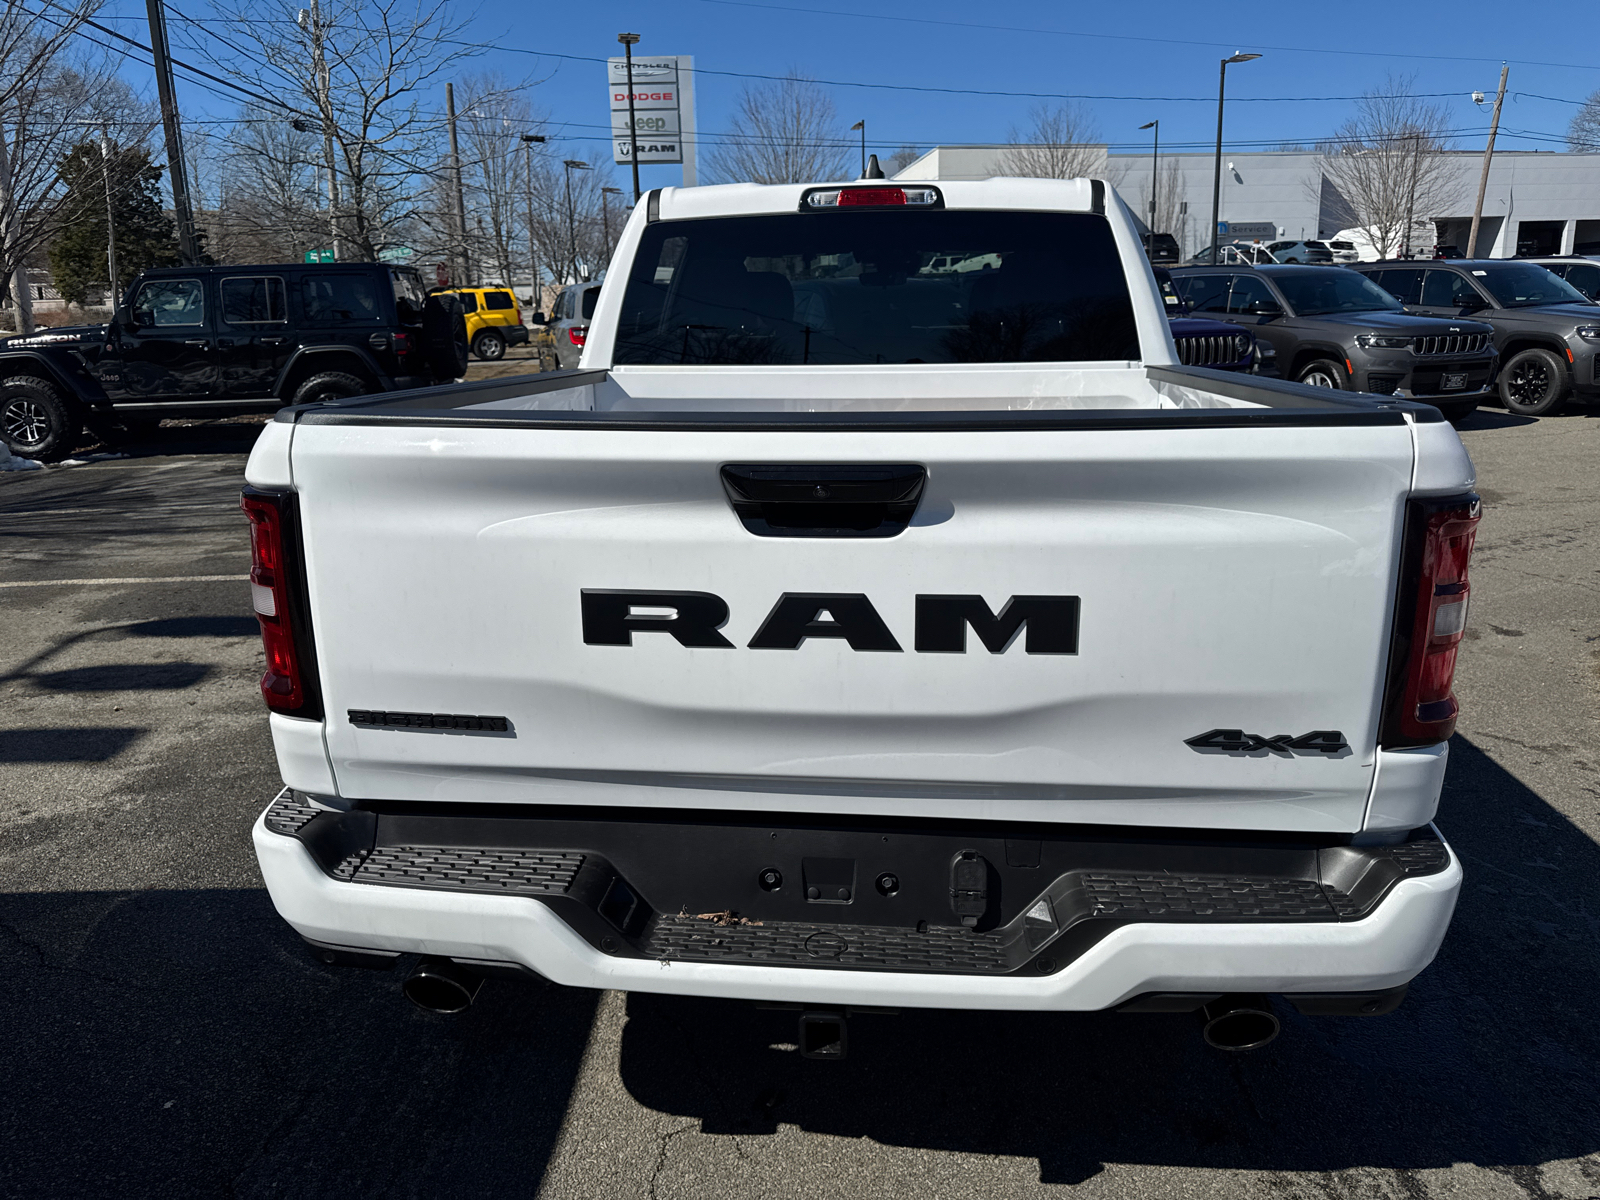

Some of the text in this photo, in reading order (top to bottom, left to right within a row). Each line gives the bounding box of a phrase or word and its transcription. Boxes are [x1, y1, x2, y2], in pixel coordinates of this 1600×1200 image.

[614, 93, 673, 101] DODGE
[7, 334, 81, 346] RUBICON
[100, 373, 120, 382] Jeep
[580, 588, 1081, 656] RAM
